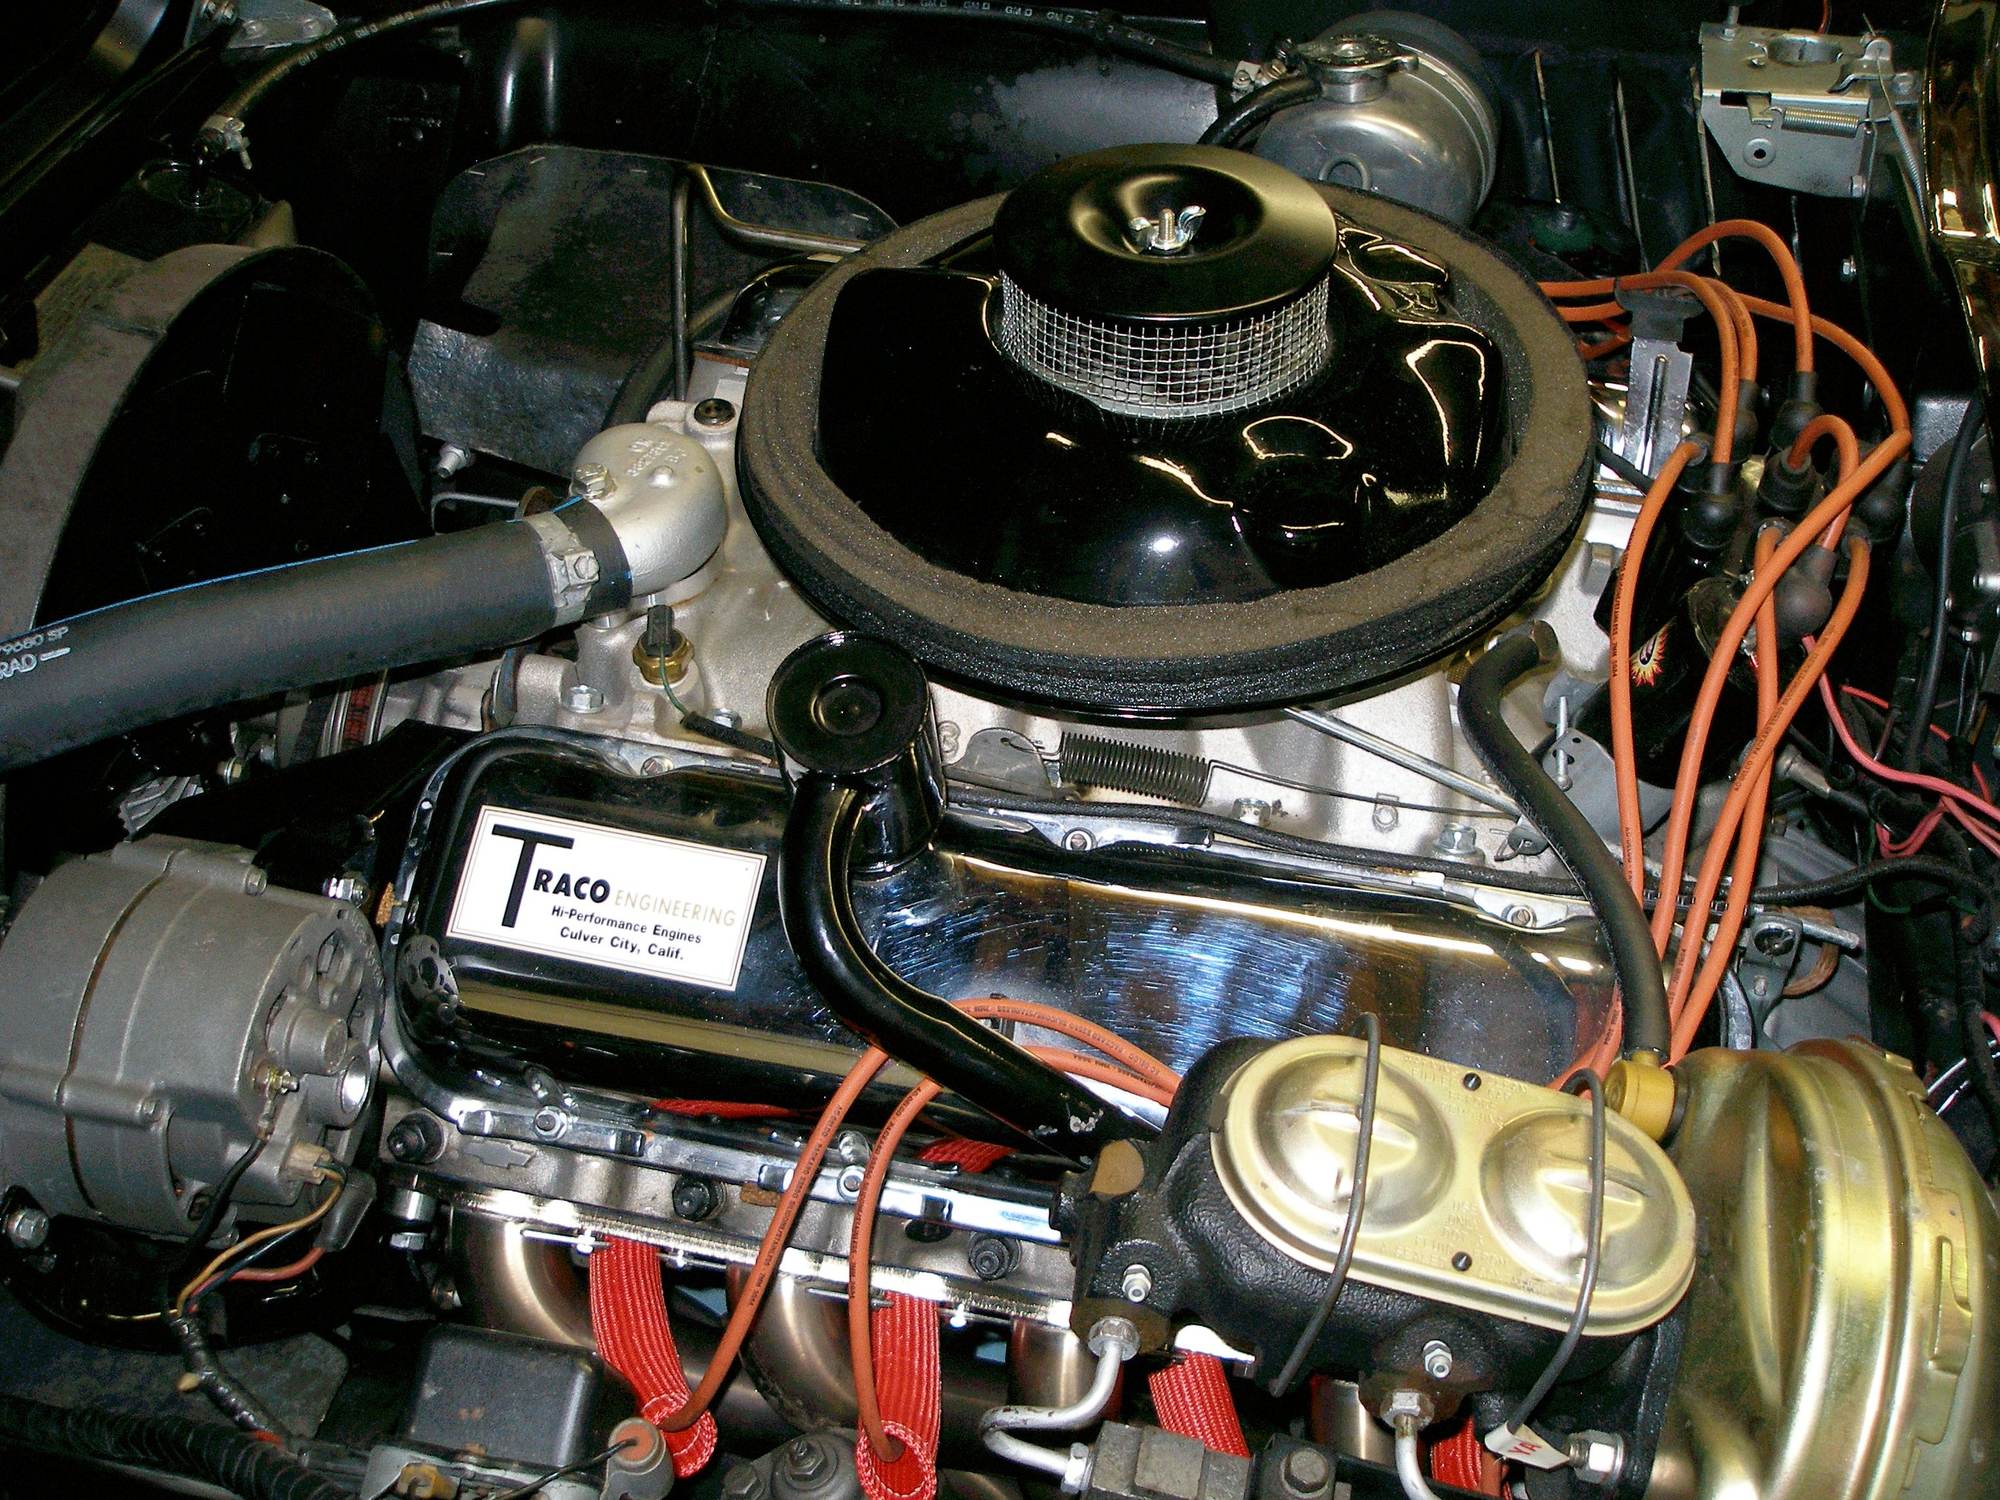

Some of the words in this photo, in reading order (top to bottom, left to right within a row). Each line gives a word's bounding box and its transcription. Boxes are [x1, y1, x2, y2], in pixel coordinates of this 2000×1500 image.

[492, 824, 611, 928] TRACO
[614, 889, 736, 927] ENGINEERING
[551, 904, 648, 934] Hi-Performance
[652, 924, 702, 944] Engines
[560, 926, 604, 945] Culver
[610, 936, 641, 954] City,
[647, 942, 684, 961] Calif.
